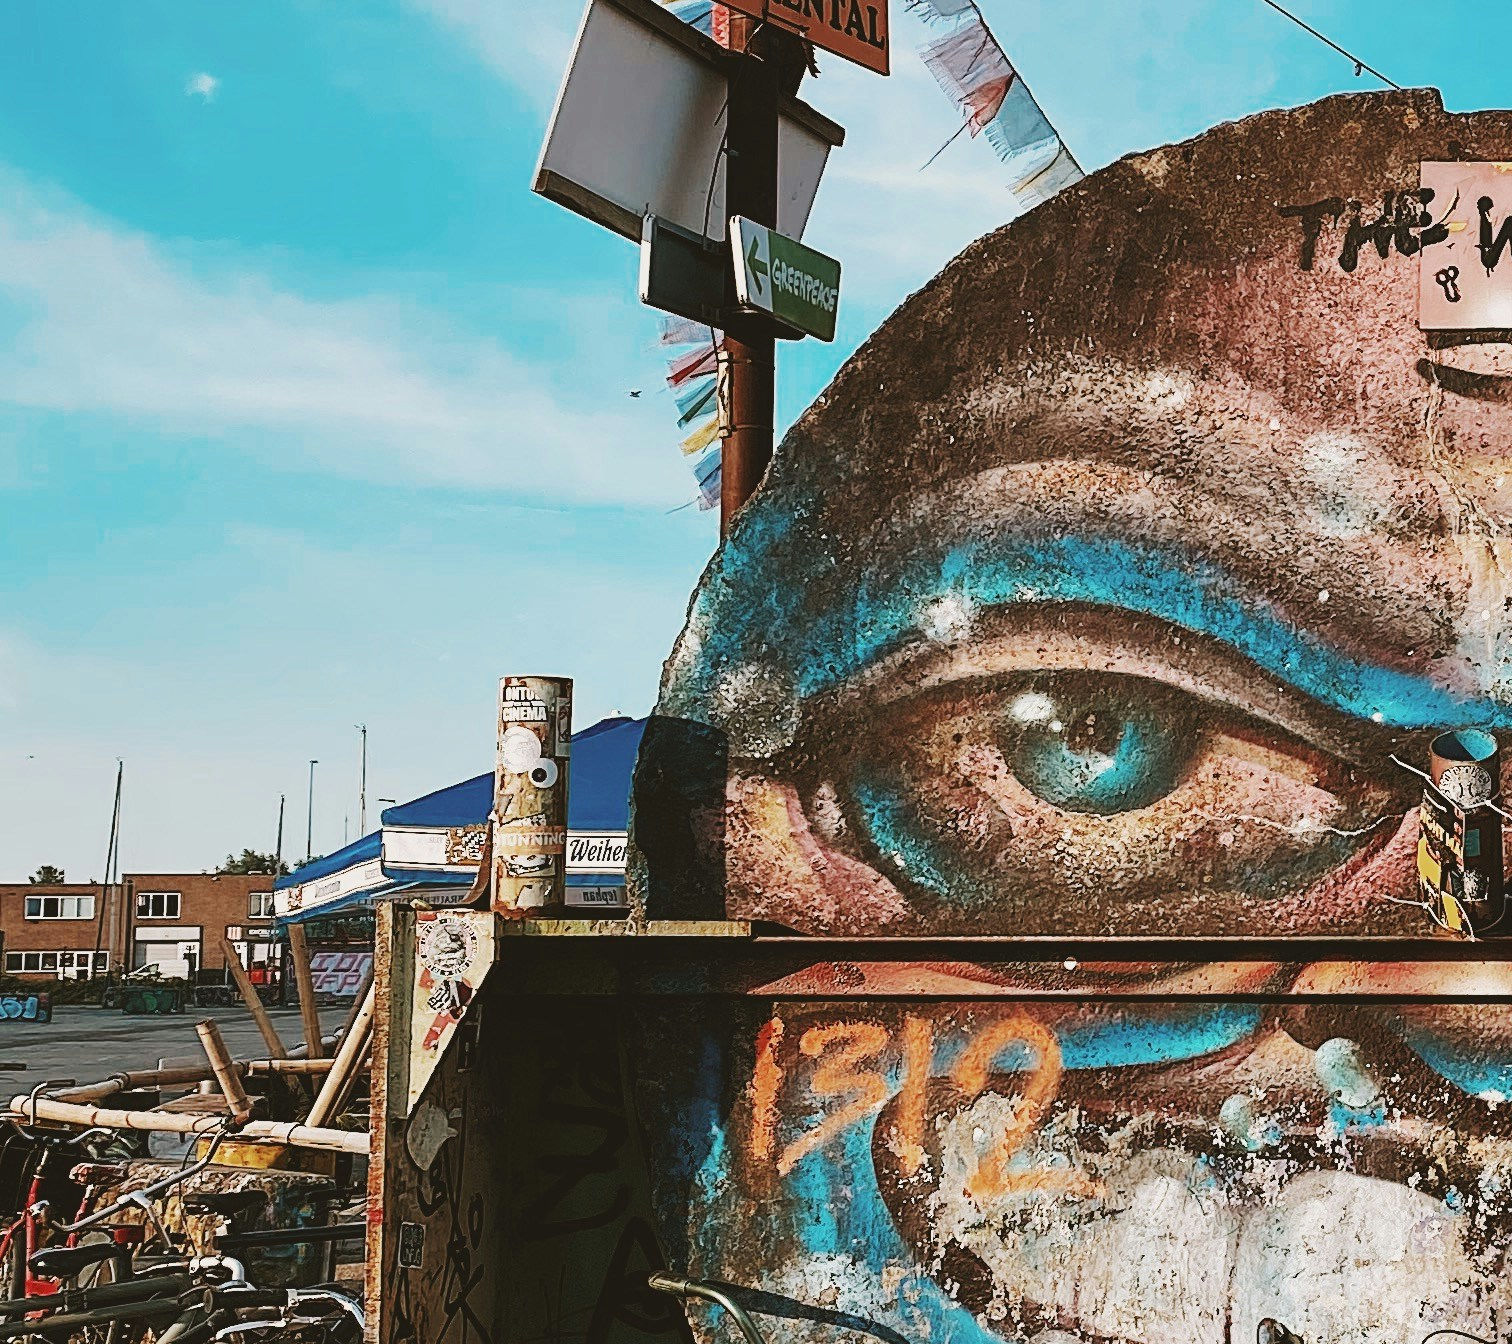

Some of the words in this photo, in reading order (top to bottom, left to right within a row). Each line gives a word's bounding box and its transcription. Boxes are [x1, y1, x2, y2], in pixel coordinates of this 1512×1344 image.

[772, 258, 838, 313] GREENPEACE
[502, 707, 547, 722] CINEMA
[747, 1011, 1107, 1199] 1312
